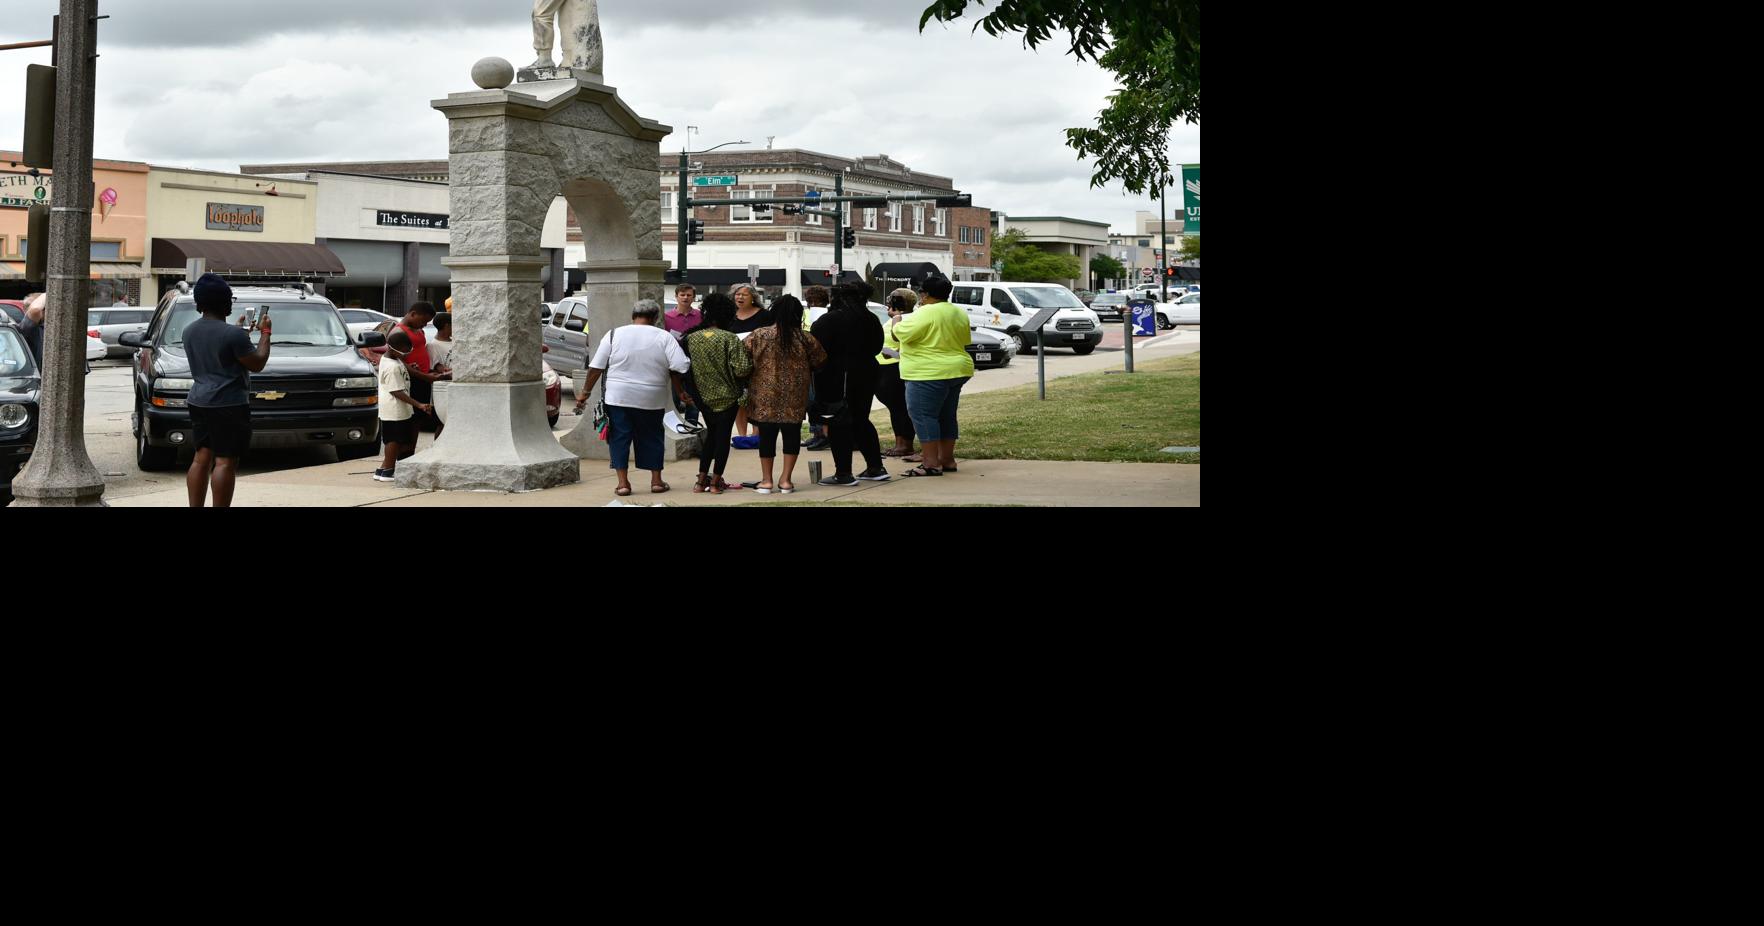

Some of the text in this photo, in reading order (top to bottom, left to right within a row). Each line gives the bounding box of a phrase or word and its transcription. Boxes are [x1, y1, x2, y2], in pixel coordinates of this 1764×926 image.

[707, 177, 721, 185] Elm
[380, 213, 398, 223] The
[400, 214, 430, 226] Suites
